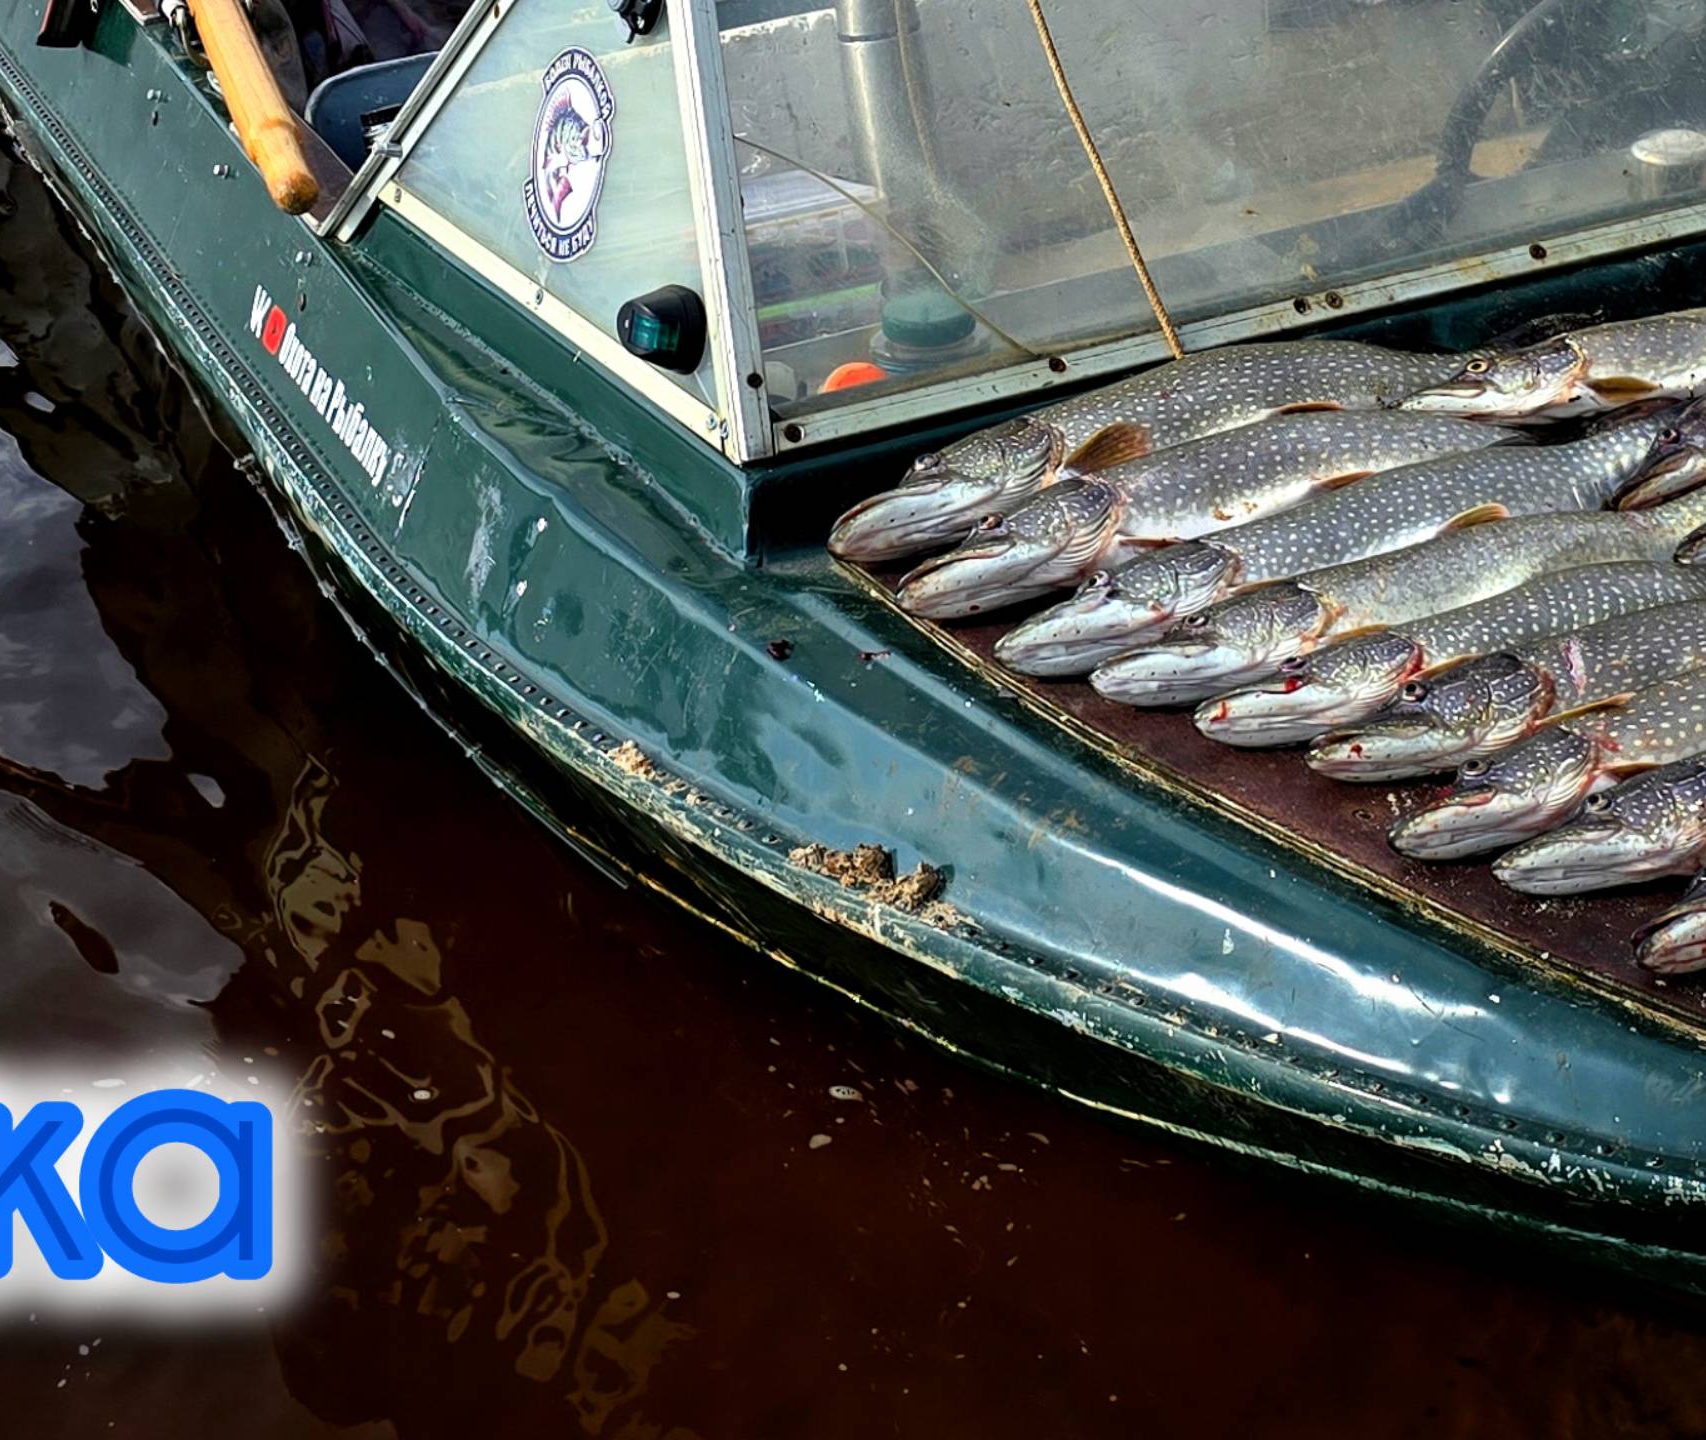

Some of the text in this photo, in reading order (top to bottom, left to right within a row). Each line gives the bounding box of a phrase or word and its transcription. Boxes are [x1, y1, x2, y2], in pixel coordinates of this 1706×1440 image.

[572, 53, 611, 119] РЫБАЛКОЙ
[525, 182, 593, 256] ЛЕЧИТЬСЯ НЕ БУДУ
[278, 322, 391, 487] Охота на Рыбалку
